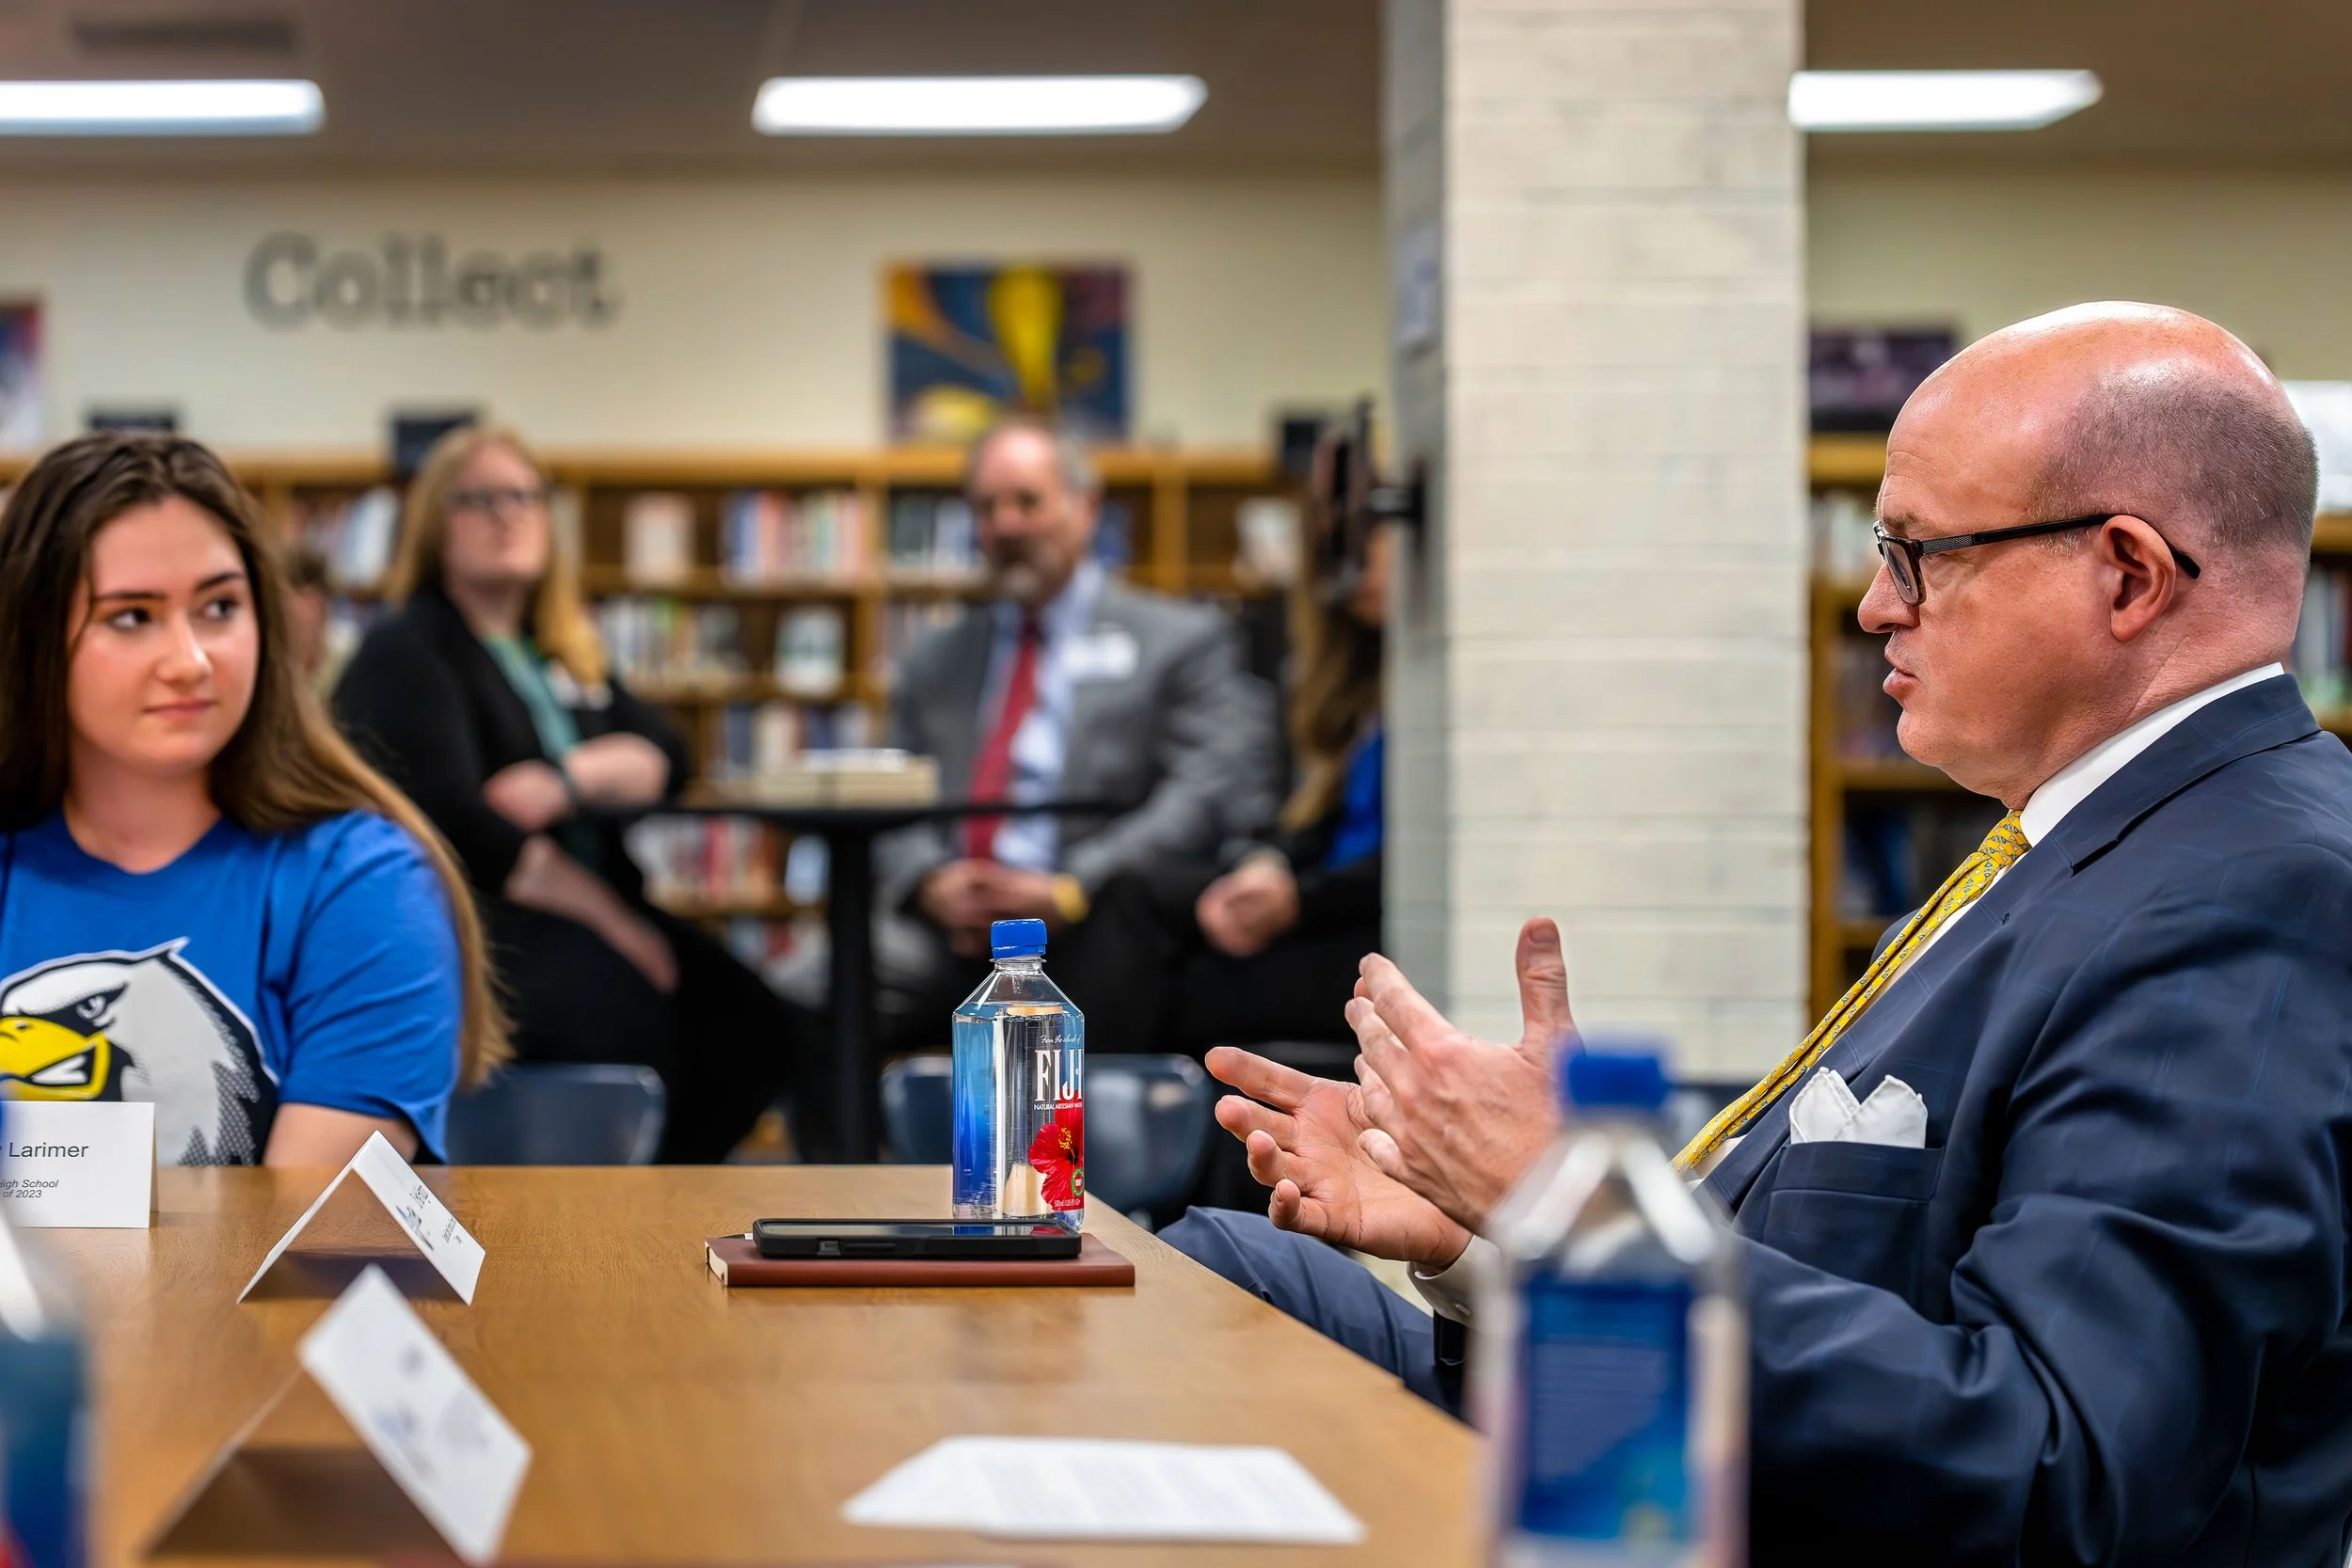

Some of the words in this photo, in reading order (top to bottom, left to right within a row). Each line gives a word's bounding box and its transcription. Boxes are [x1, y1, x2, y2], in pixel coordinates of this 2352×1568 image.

[245, 230, 623, 333] Collect
[9, 1142, 89, 1157] Larimer
[21, 1179, 59, 1188] School
[2, 1189, 14, 1198] of
[15, 1189, 42, 1198] 2023
